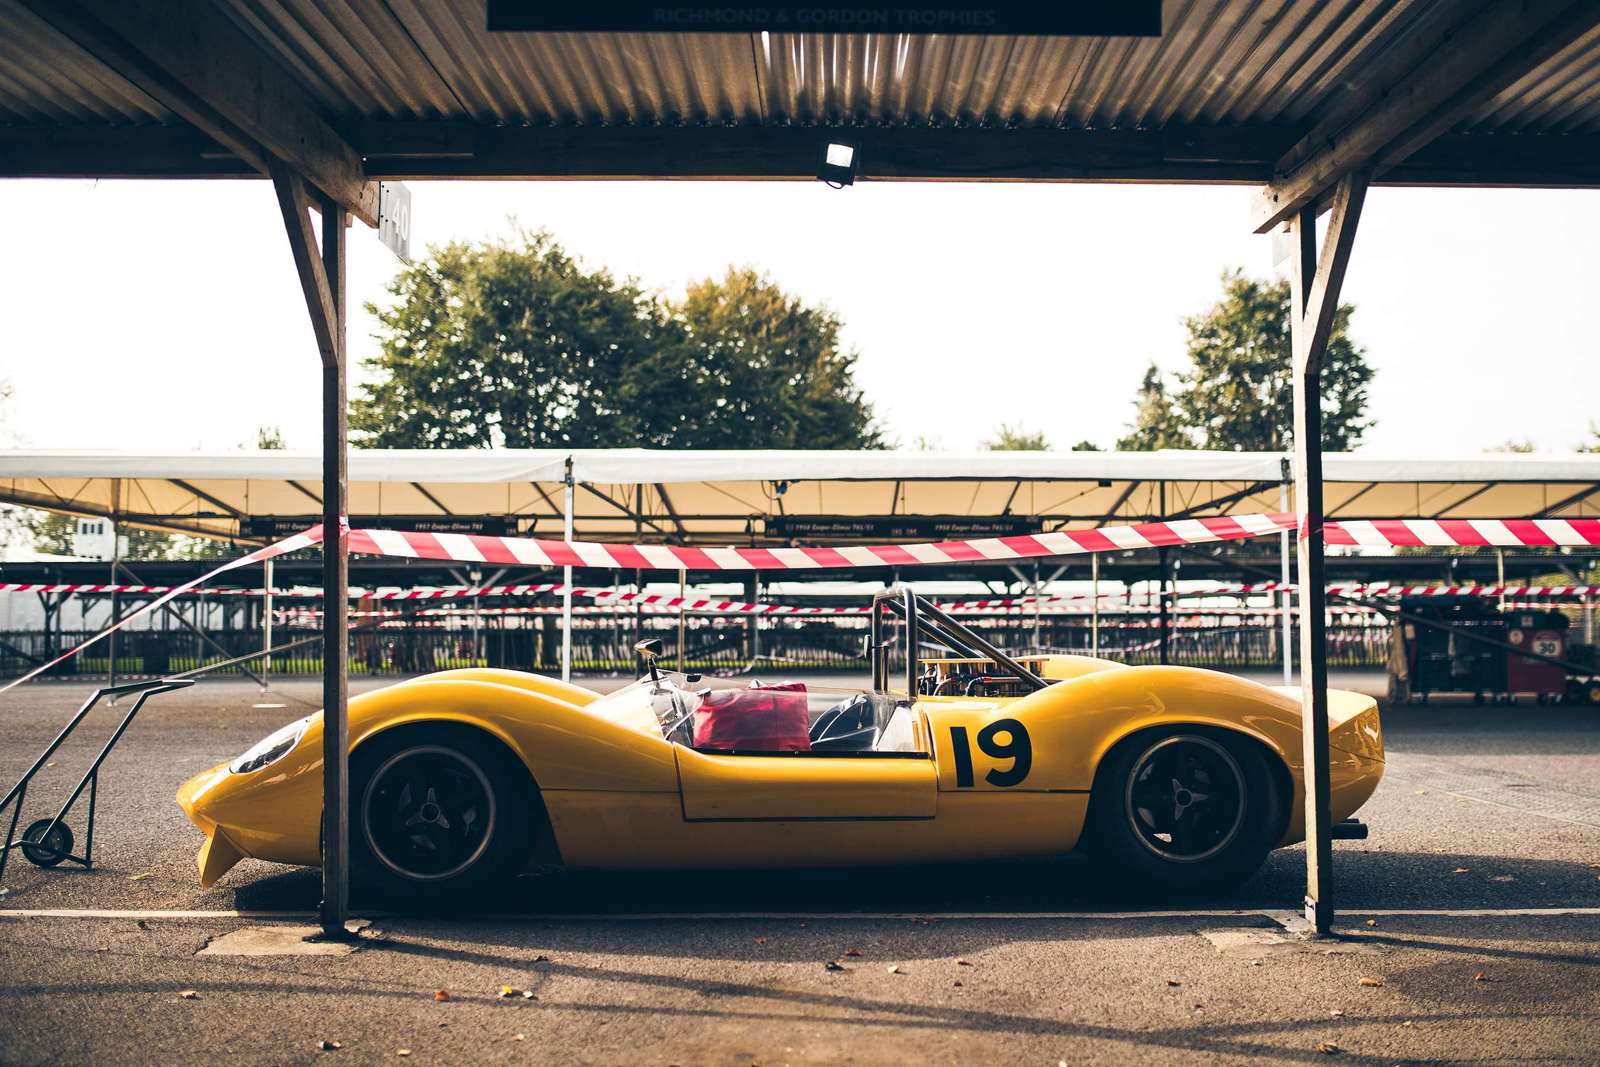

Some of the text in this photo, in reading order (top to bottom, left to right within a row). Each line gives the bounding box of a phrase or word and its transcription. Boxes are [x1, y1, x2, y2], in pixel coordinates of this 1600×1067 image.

[653, 8, 996, 26] RICHMOND & GORDON TROPHIES
[391, 197, 409, 241] 40
[949, 718, 1033, 788] 19
